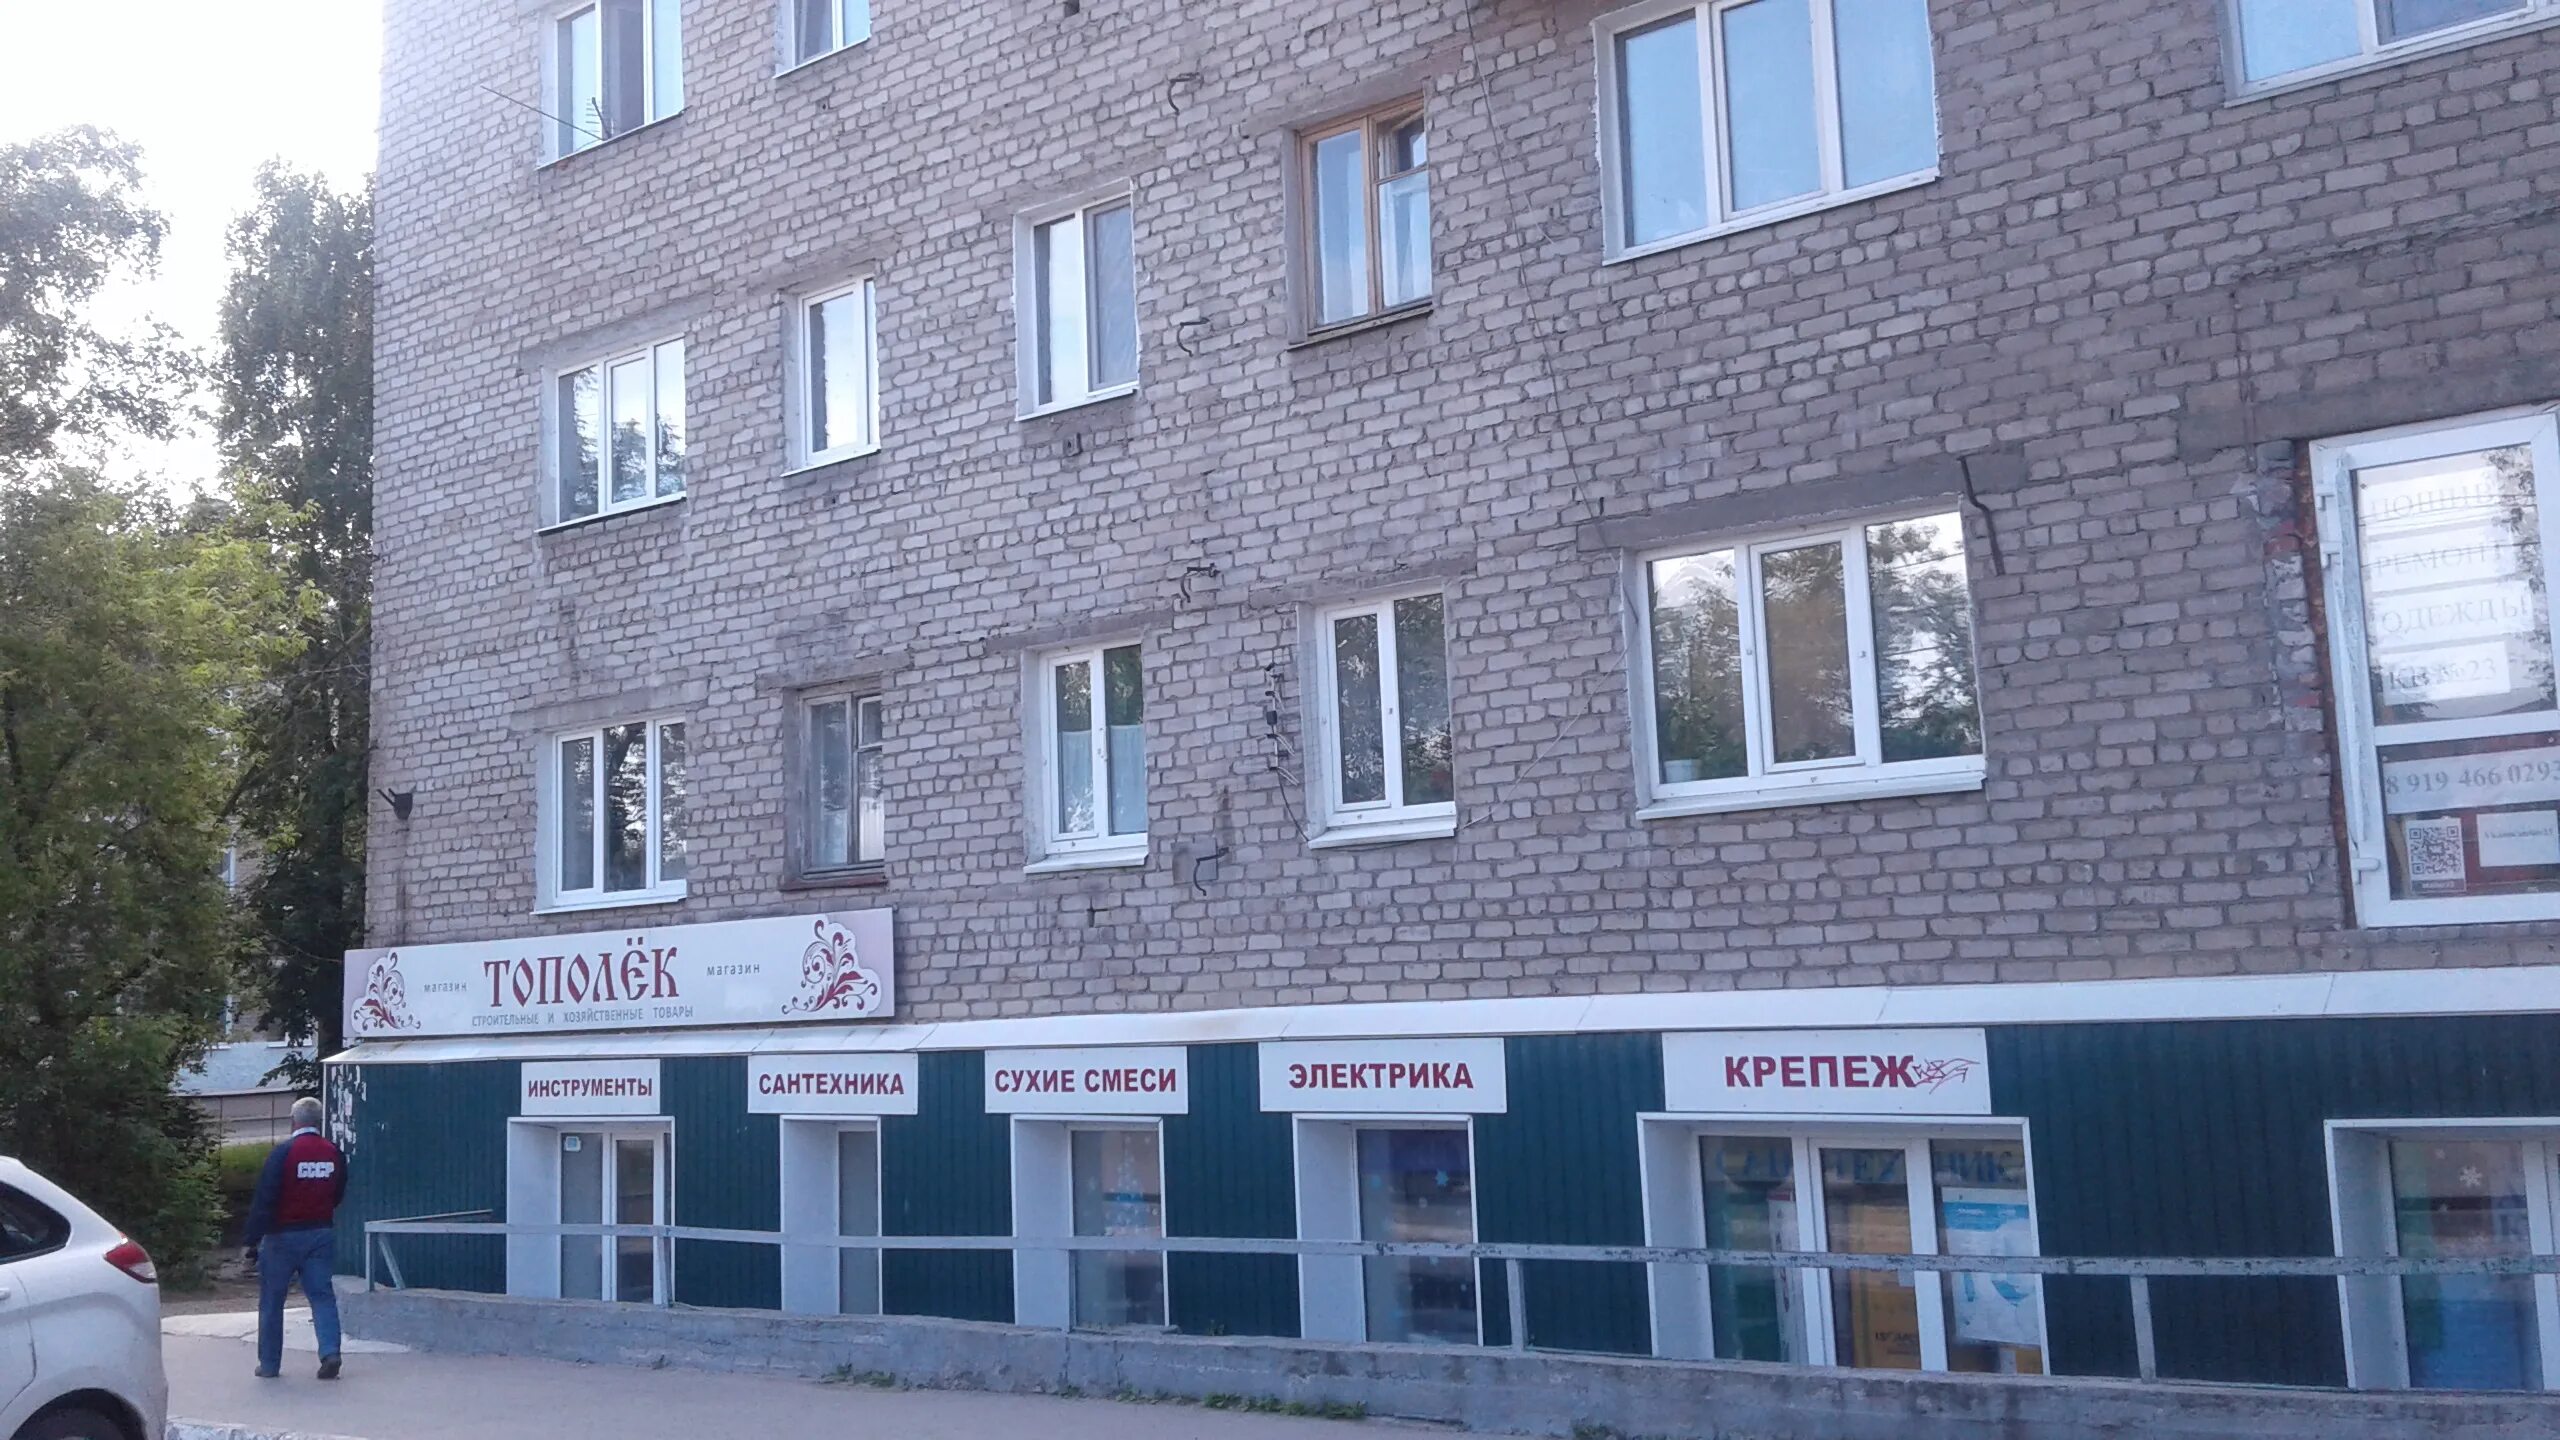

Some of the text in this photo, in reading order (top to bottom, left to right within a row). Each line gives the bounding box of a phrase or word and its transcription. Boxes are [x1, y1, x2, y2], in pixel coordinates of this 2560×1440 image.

[2382, 596, 2528, 634] ОДЕЖДЫ
[2386, 775, 2400, 795] 8
[2408, 771, 2449, 793] 919
[2459, 767, 2501, 788] 466
[484, 936, 679, 1008] ТОПОЛЁК
[707, 963, 760, 976] магазин
[423, 981, 467, 993] магазин
[471, 1005, 694, 1027] СТРОИТЕЛЬНЫЕ И ХОЗЯЙСТВЕННЫЕ ТОВАРЫ
[758, 1073, 905, 1095] САНТЕХНИКА
[994, 1068, 1177, 1093] СУХИЕ СМЕСИ
[1288, 1062, 1474, 1089] ЭЛЕКТРИКА
[1725, 1055, 1917, 1088] КРЕПЕЖ
[527, 1077, 653, 1098] ИНСТРУМЕНТЫ
